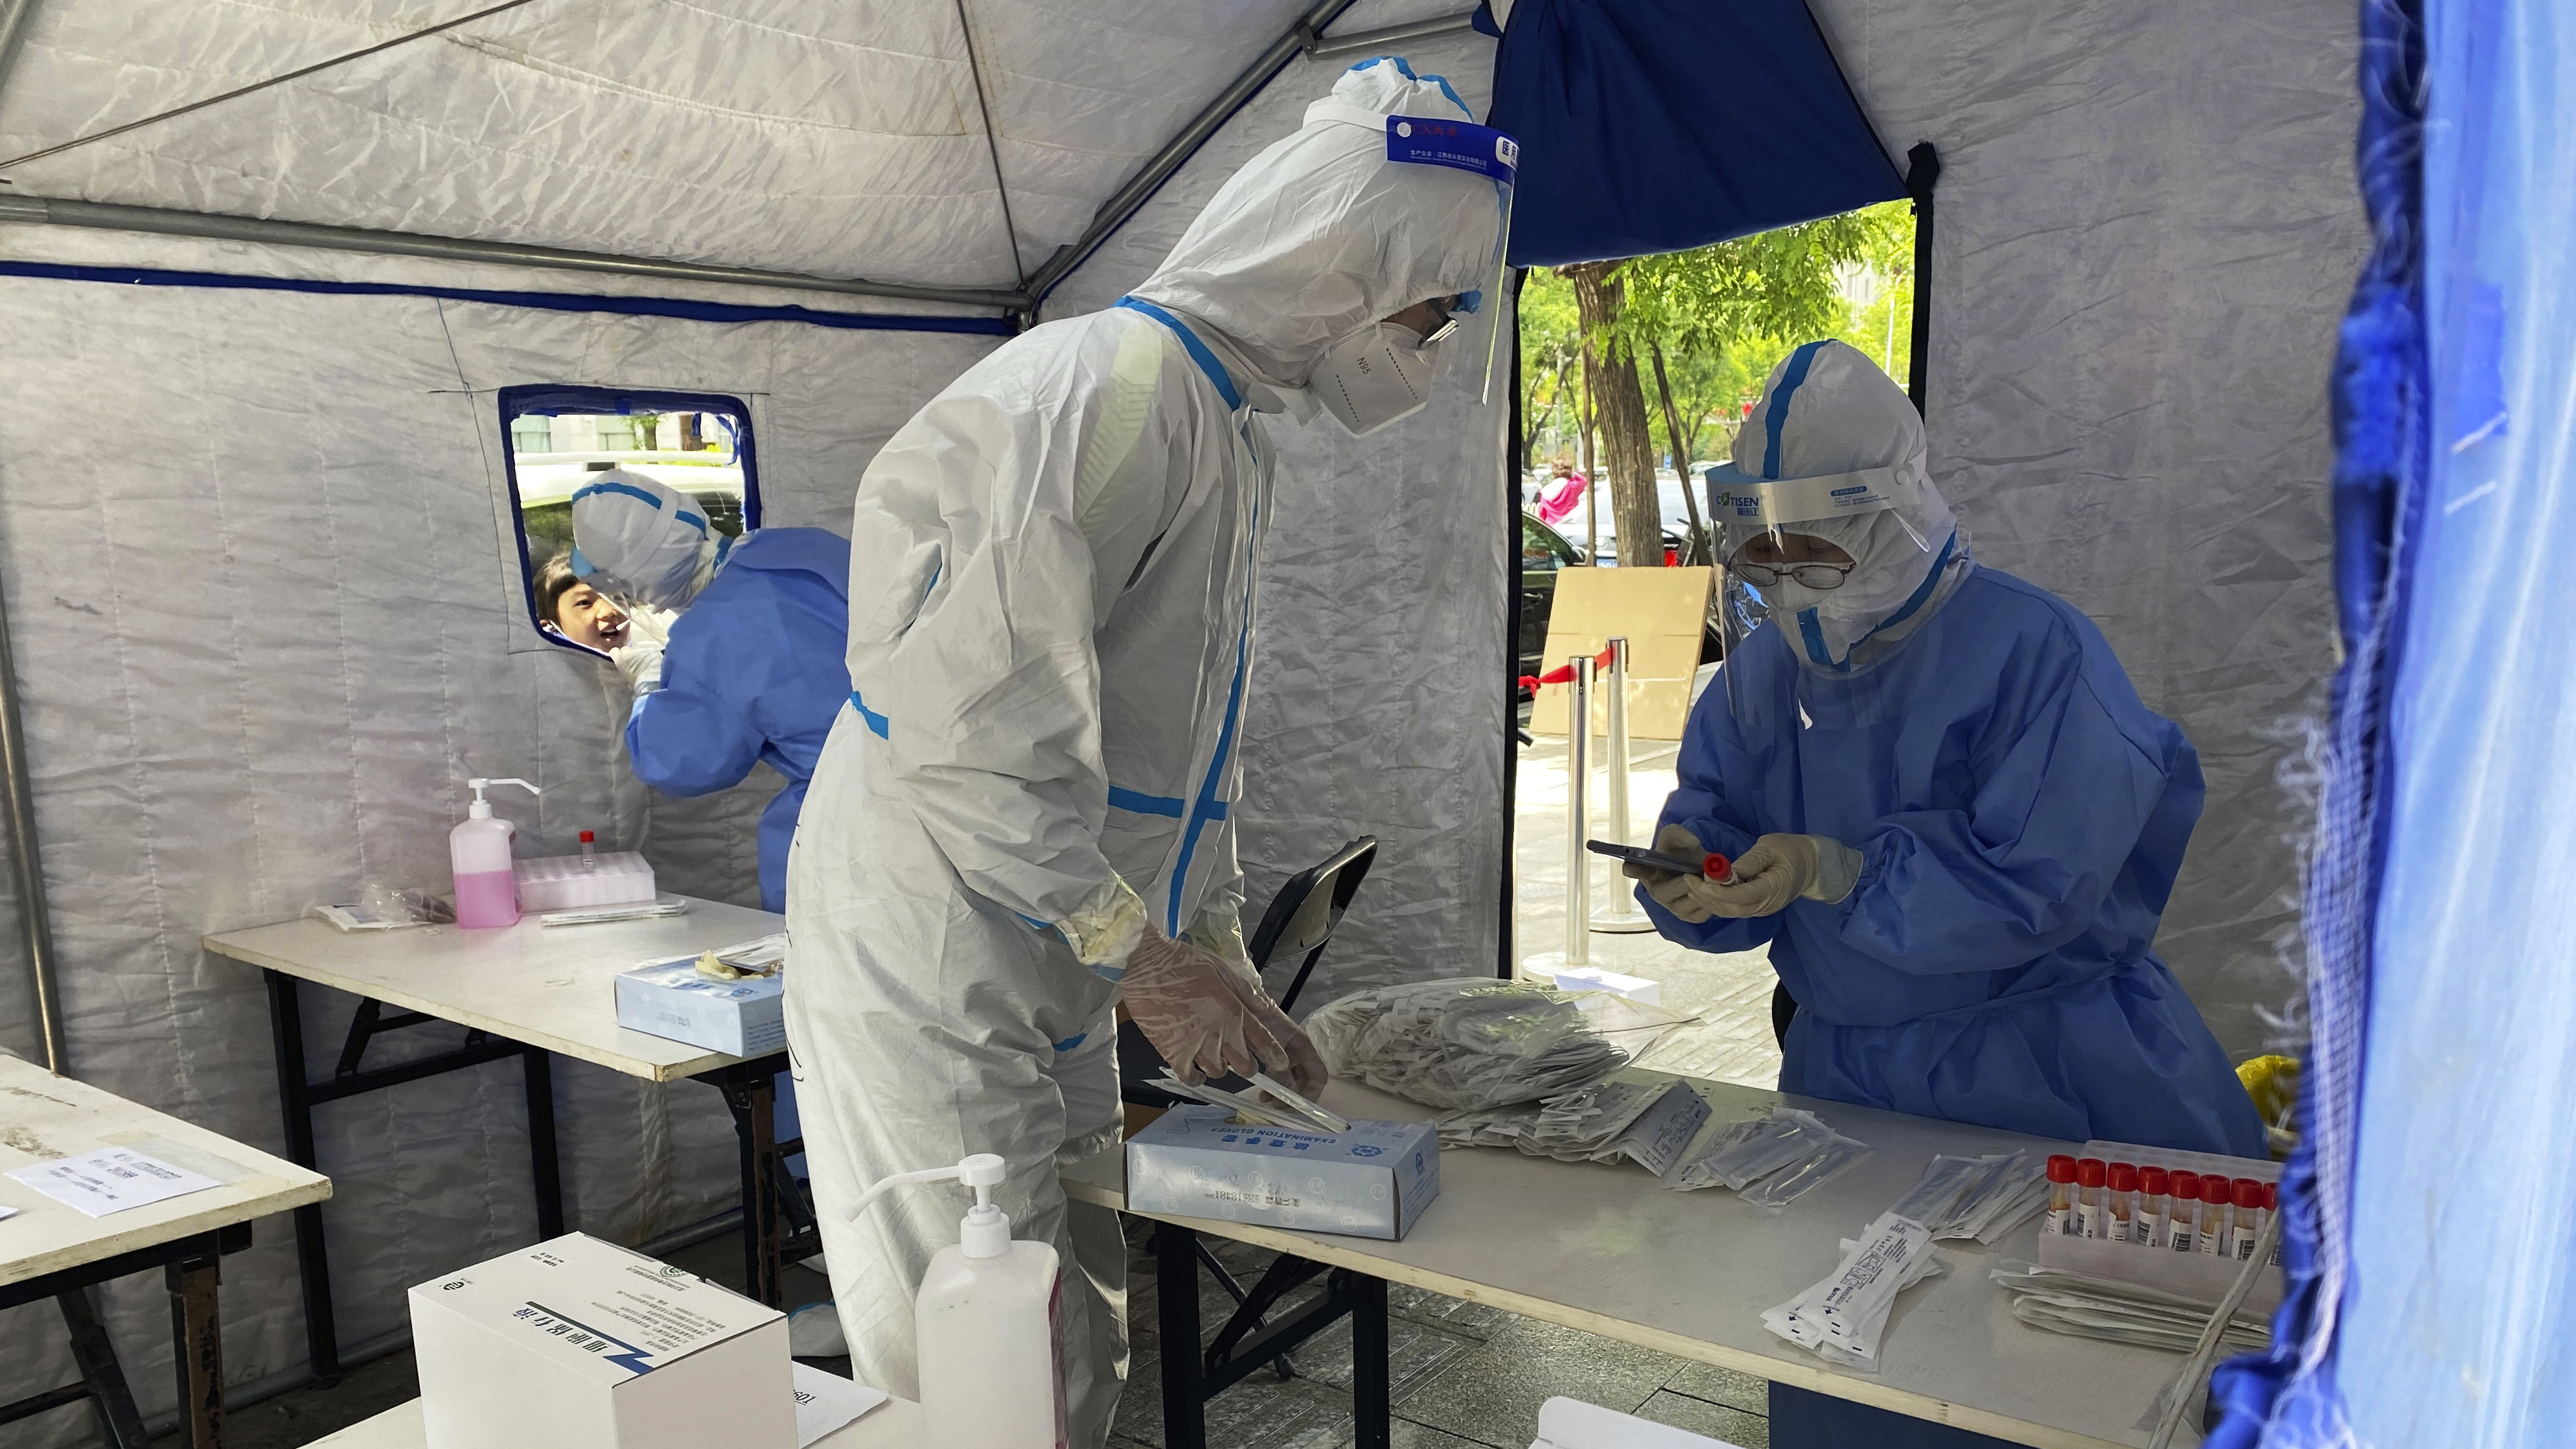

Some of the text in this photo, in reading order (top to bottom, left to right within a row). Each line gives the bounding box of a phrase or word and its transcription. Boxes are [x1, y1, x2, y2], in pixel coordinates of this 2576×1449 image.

[1357, 357, 1371, 375] N95
[1210, 1127, 1337, 1144] EXAMINATION GLOVES
[793, 1389, 816, 1404] 601
